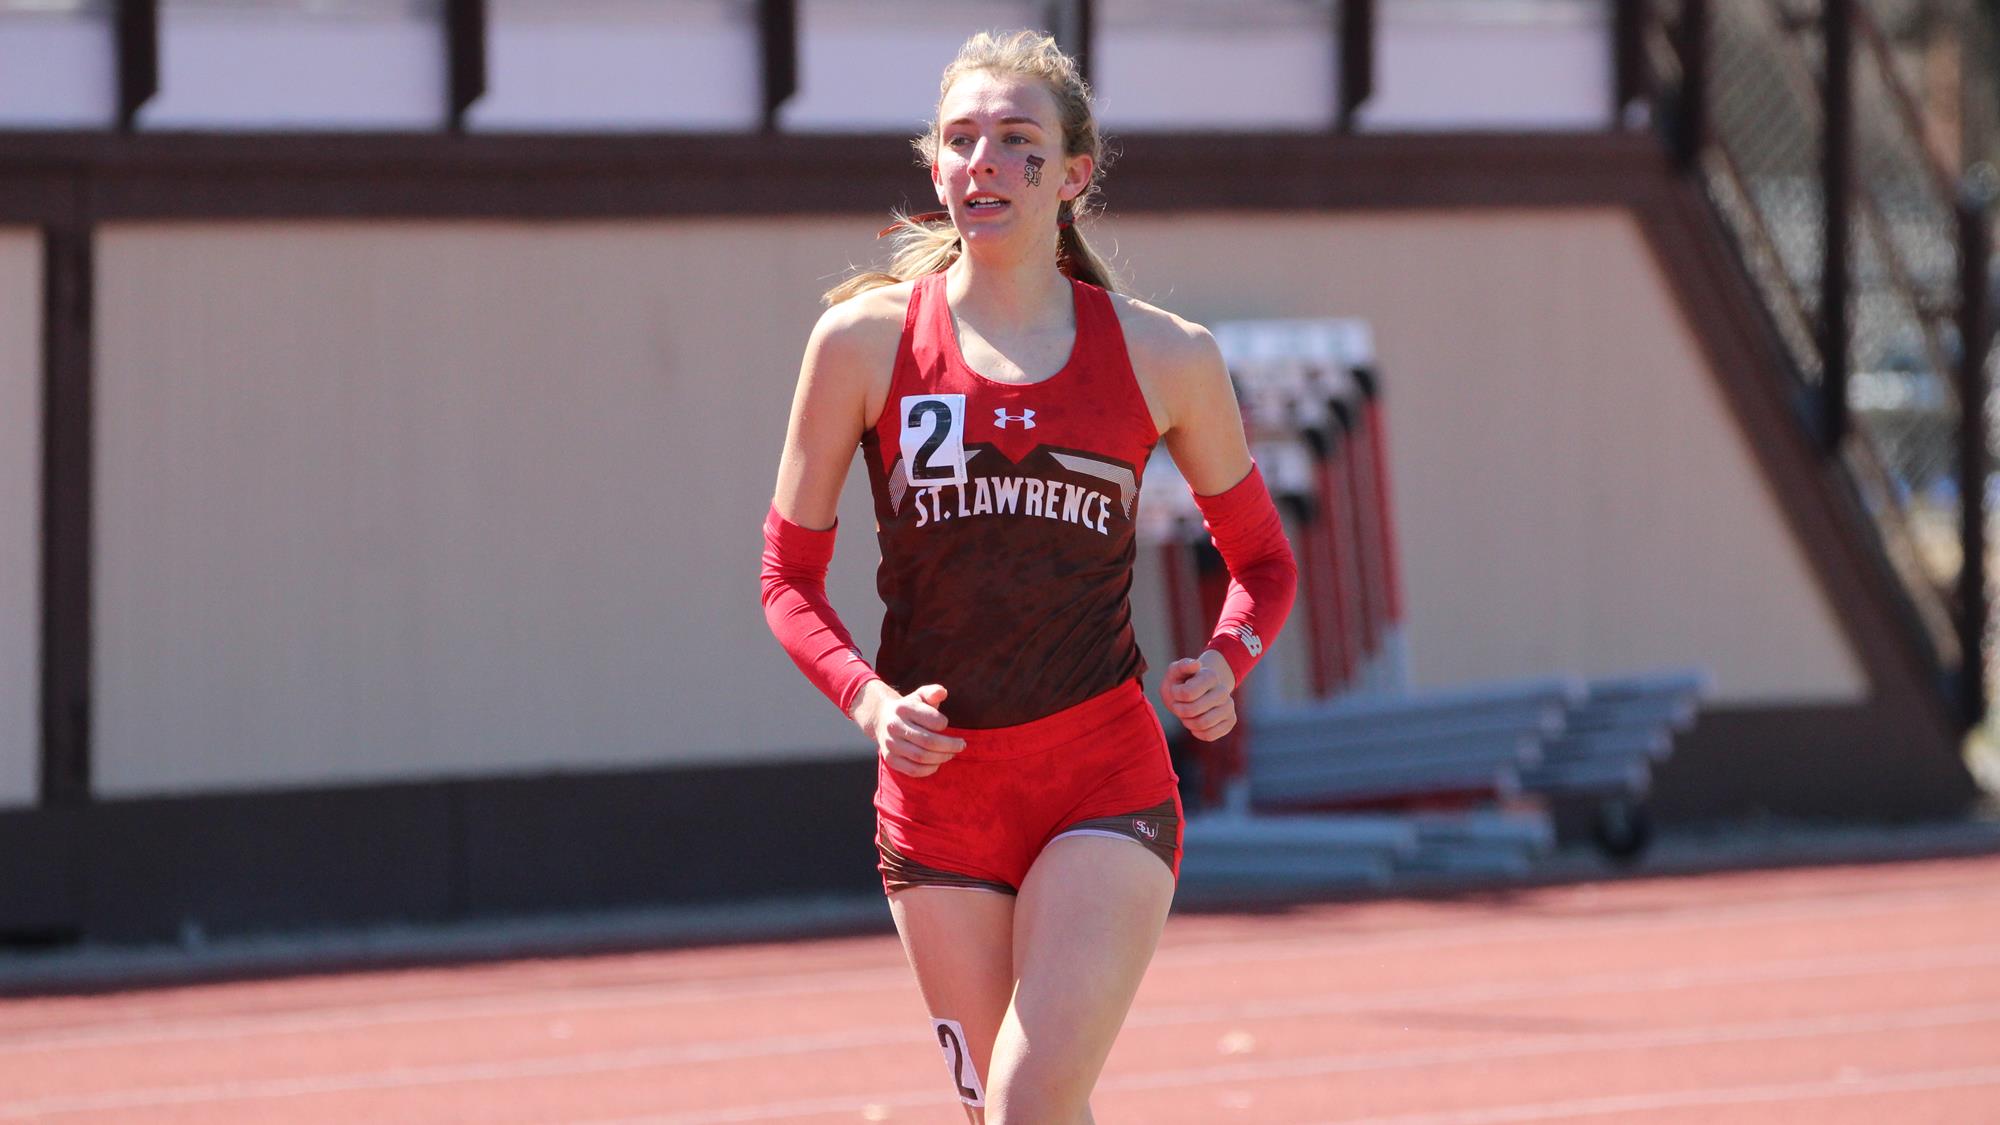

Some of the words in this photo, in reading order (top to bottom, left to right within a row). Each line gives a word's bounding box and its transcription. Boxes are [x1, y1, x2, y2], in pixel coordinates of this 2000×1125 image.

[908, 399, 955, 480] 2
[915, 485, 951, 528] ST.
[957, 476, 1112, 536] LAWRENCE
[937, 1023, 979, 1101] 2
